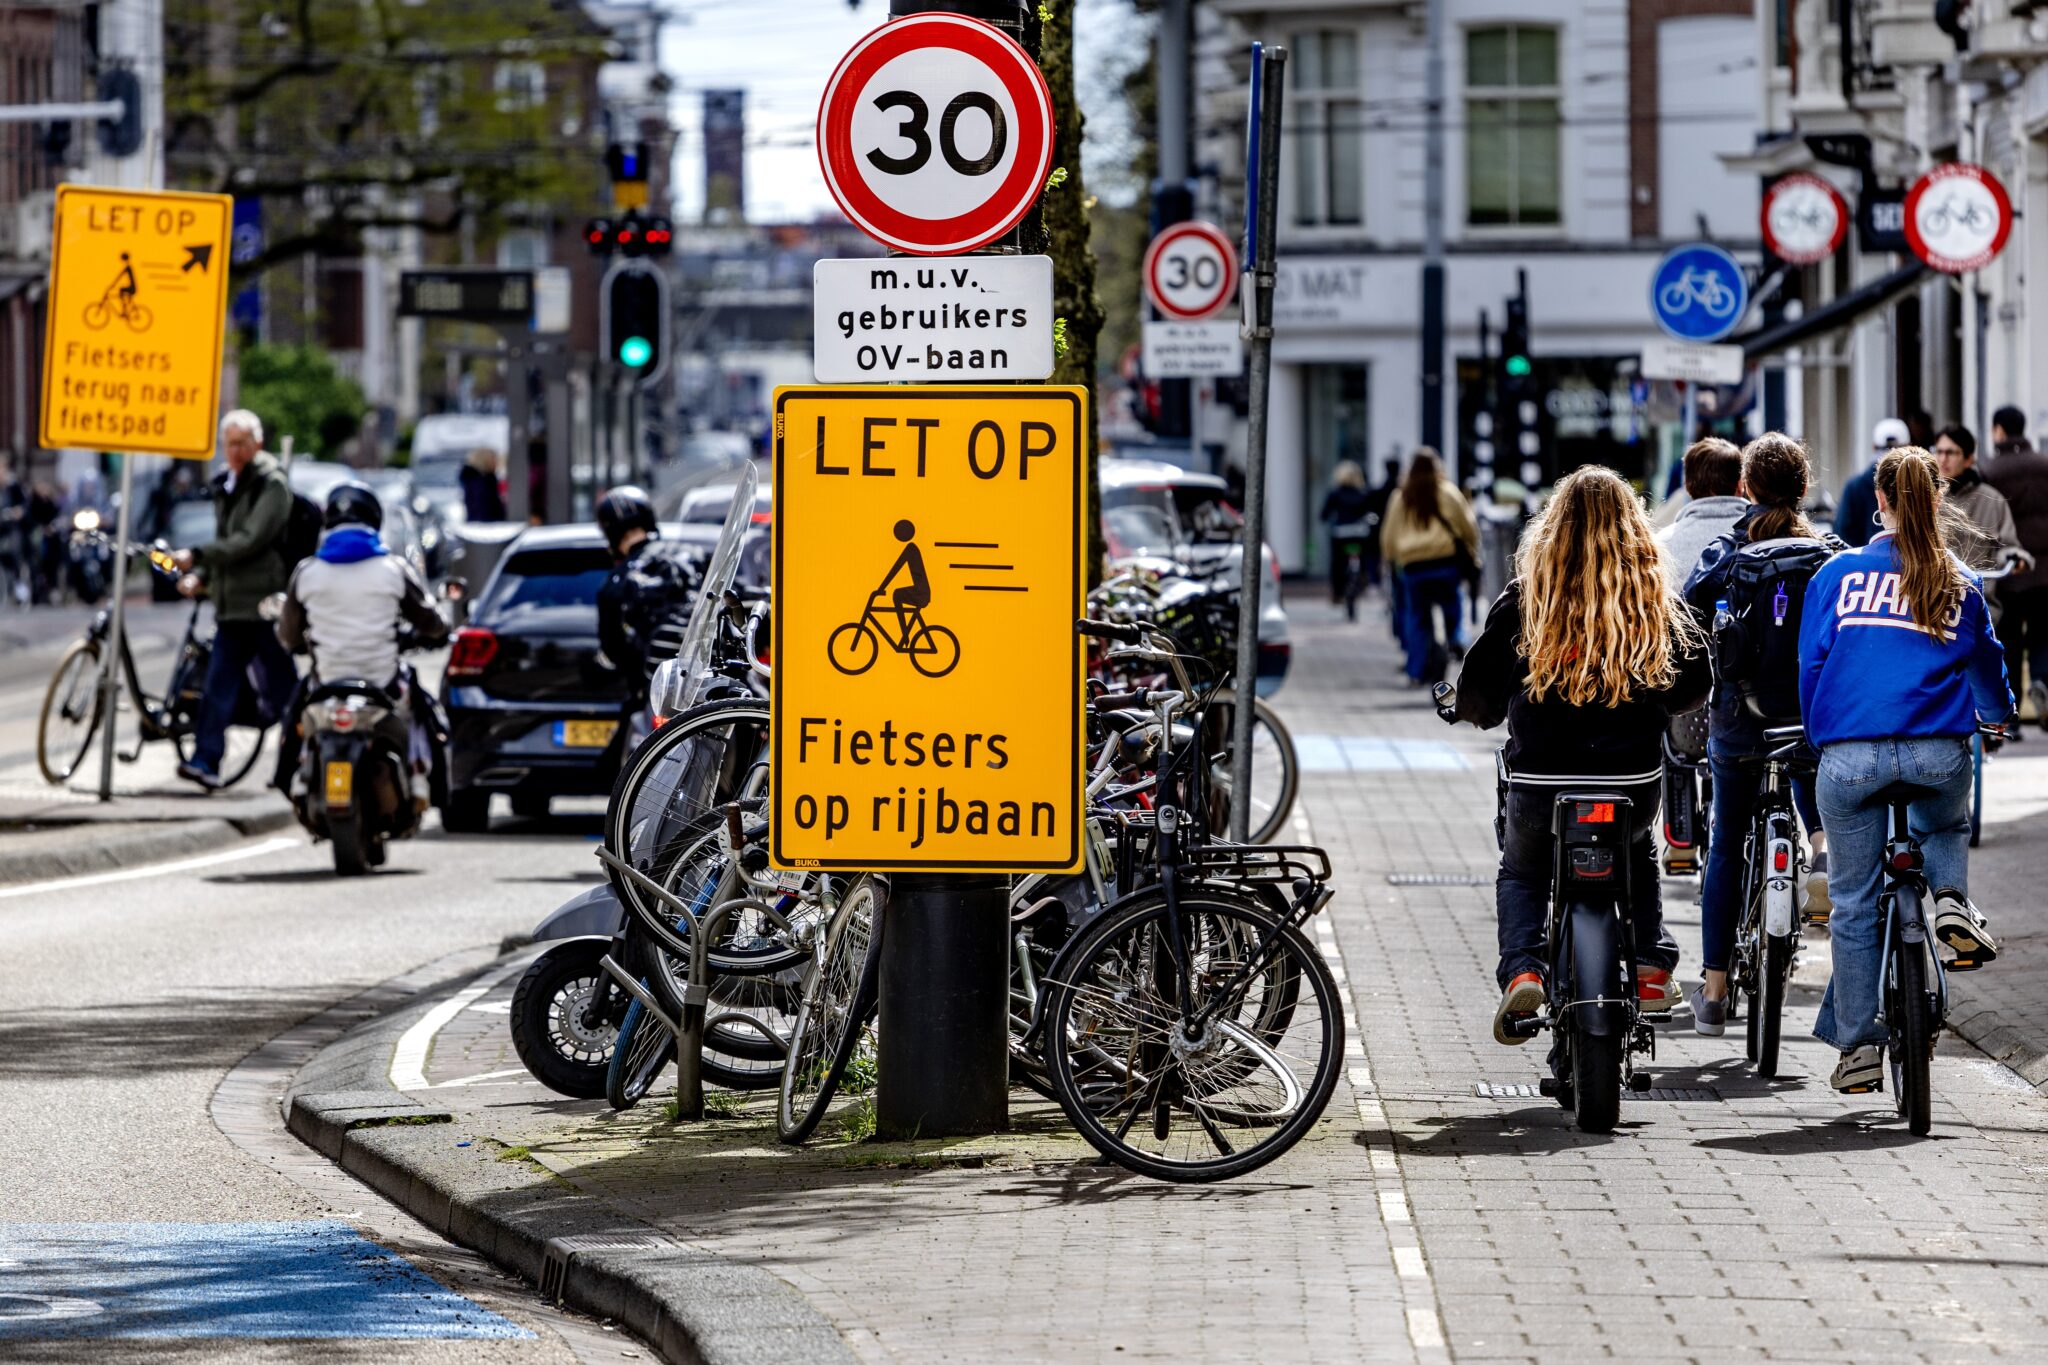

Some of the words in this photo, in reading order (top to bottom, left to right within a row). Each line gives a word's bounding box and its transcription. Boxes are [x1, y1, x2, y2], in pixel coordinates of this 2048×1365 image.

[866, 90, 1008, 177] 30
[88, 204, 144, 233] LET
[155, 208, 196, 236] OP
[870, 268, 978, 290] m.u.v.
[1165, 256, 1219, 289] 30
[837, 302, 1028, 340] gebruikers
[65, 340, 171, 372] Fietsers
[856, 343, 1008, 371] OV-baan
[62, 375, 131, 408] terug
[140, 385, 200, 406] naar
[59, 404, 167, 437] fietspad
[815, 415, 940, 478] LET
[967, 419, 1057, 481] OP
[1836, 570, 1967, 628] GIAS
[799, 717, 1009, 770] Fietsers
[794, 794, 849, 841] op
[872, 786, 1055, 849] rijbaan
